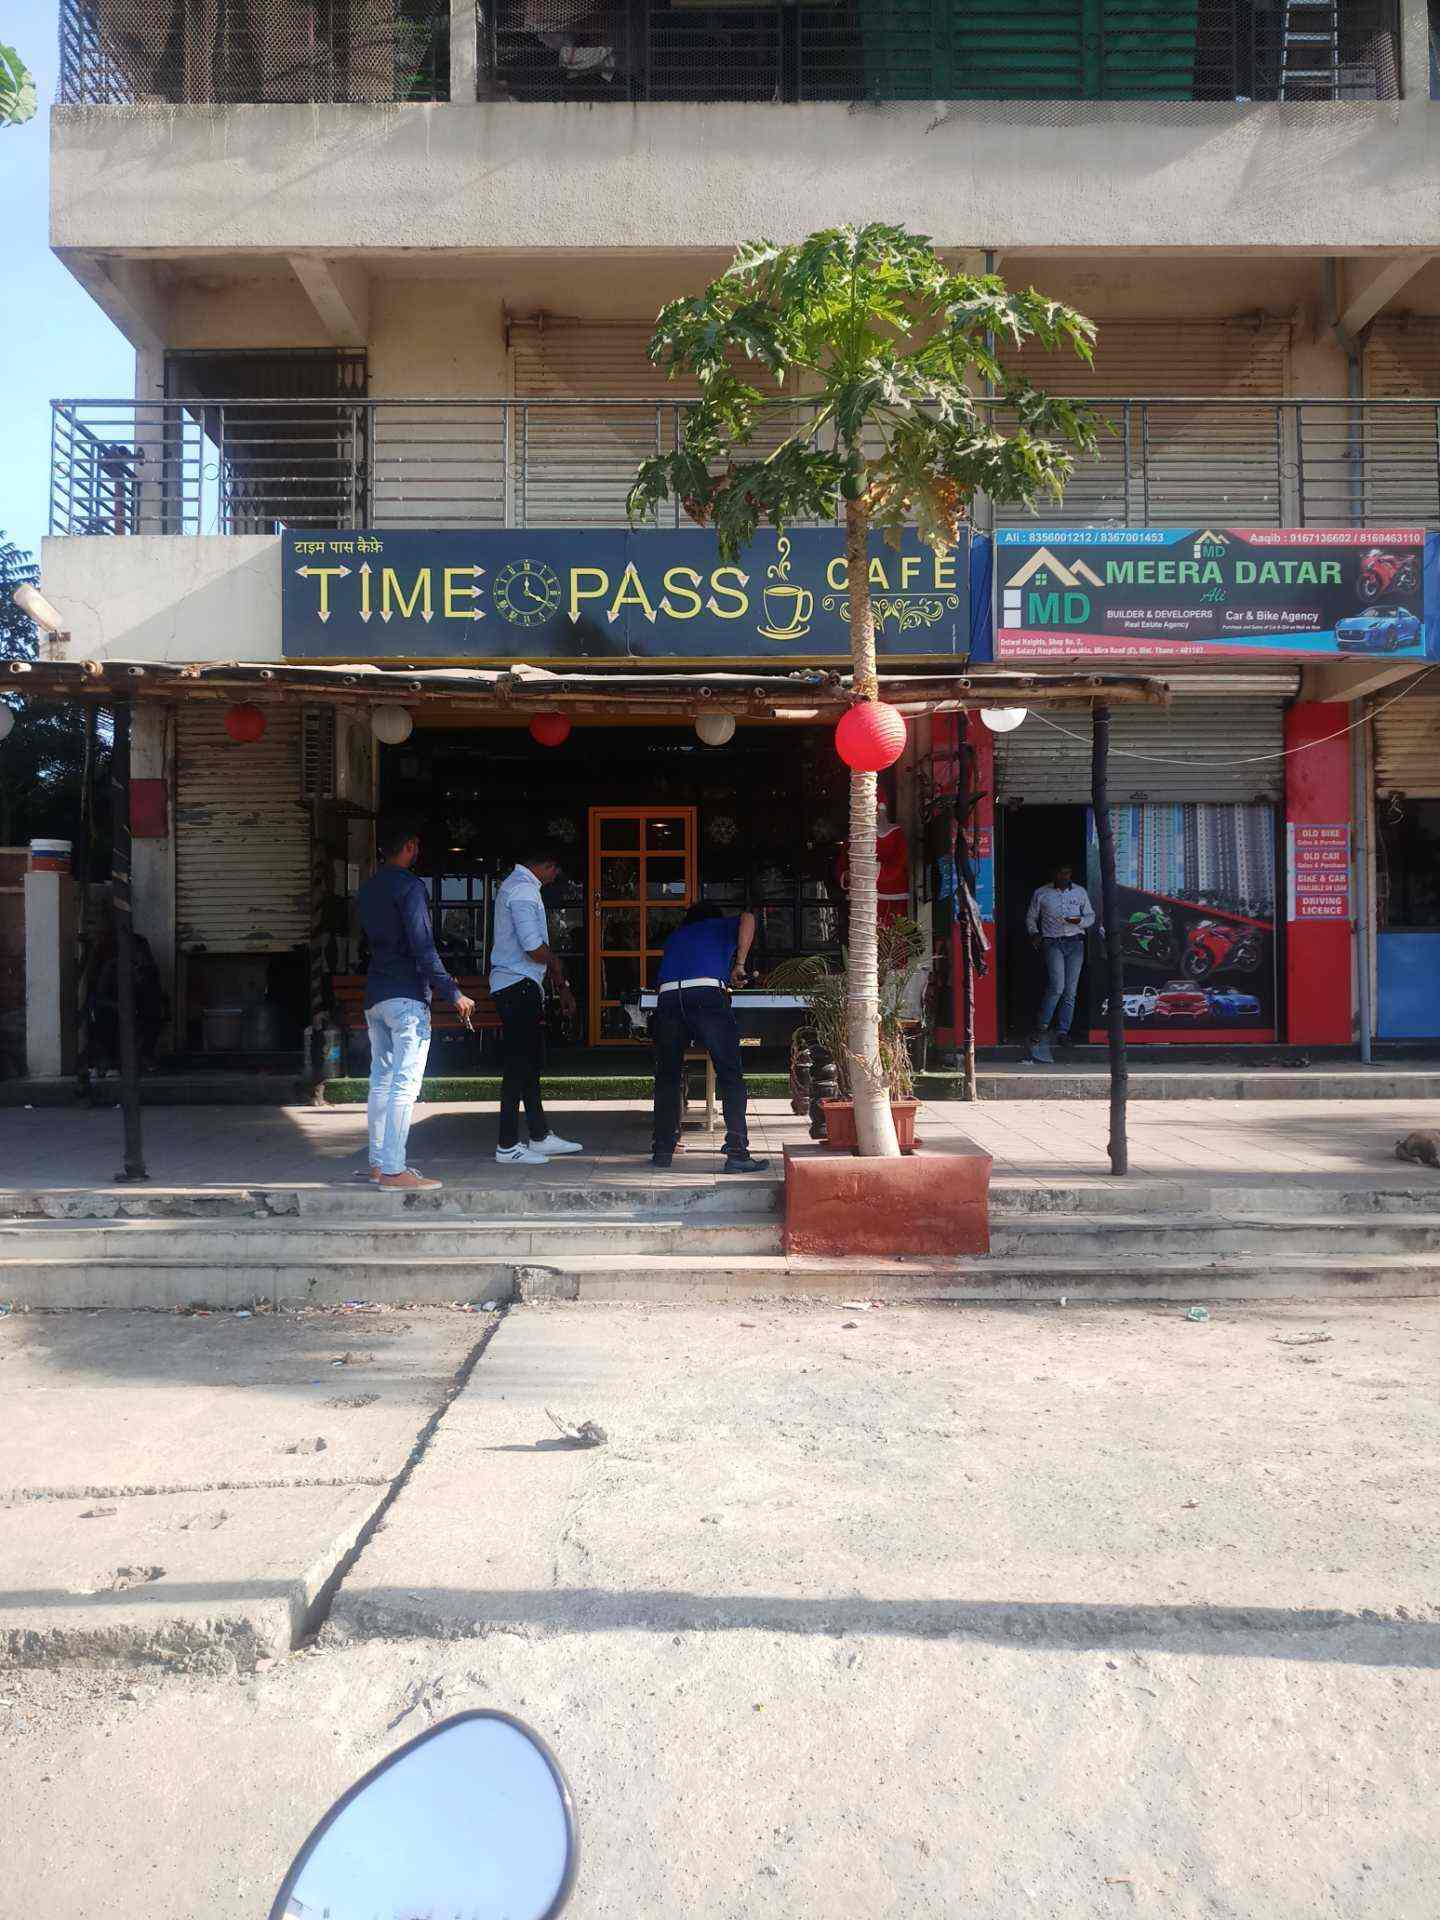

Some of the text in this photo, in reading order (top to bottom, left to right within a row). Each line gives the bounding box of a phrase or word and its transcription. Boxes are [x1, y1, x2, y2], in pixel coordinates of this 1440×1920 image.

[1005, 533, 1019, 543] Ali
[1249, 533, 1281, 545] Aaqib
[294, 541, 325, 555] टाइम
[328, 541, 354, 554] पास
[1106, 560, 1342, 584] MEERA DATAR
[294, 561, 487, 624] TIME
[567, 561, 750, 624] PASS
[1028, 592, 1091, 625] MD
[1107, 609, 1213, 619] BUILDER & DEVELOPERS
[1225, 610, 1319, 623] Car & Bike Agency
[1125, 621, 1190, 631] Real Estate Agency
[1303, 852, 1340, 860] OLD CAR
[1302, 897, 1342, 905] DRIVING
[1302, 907, 1343, 915] LICENCE
